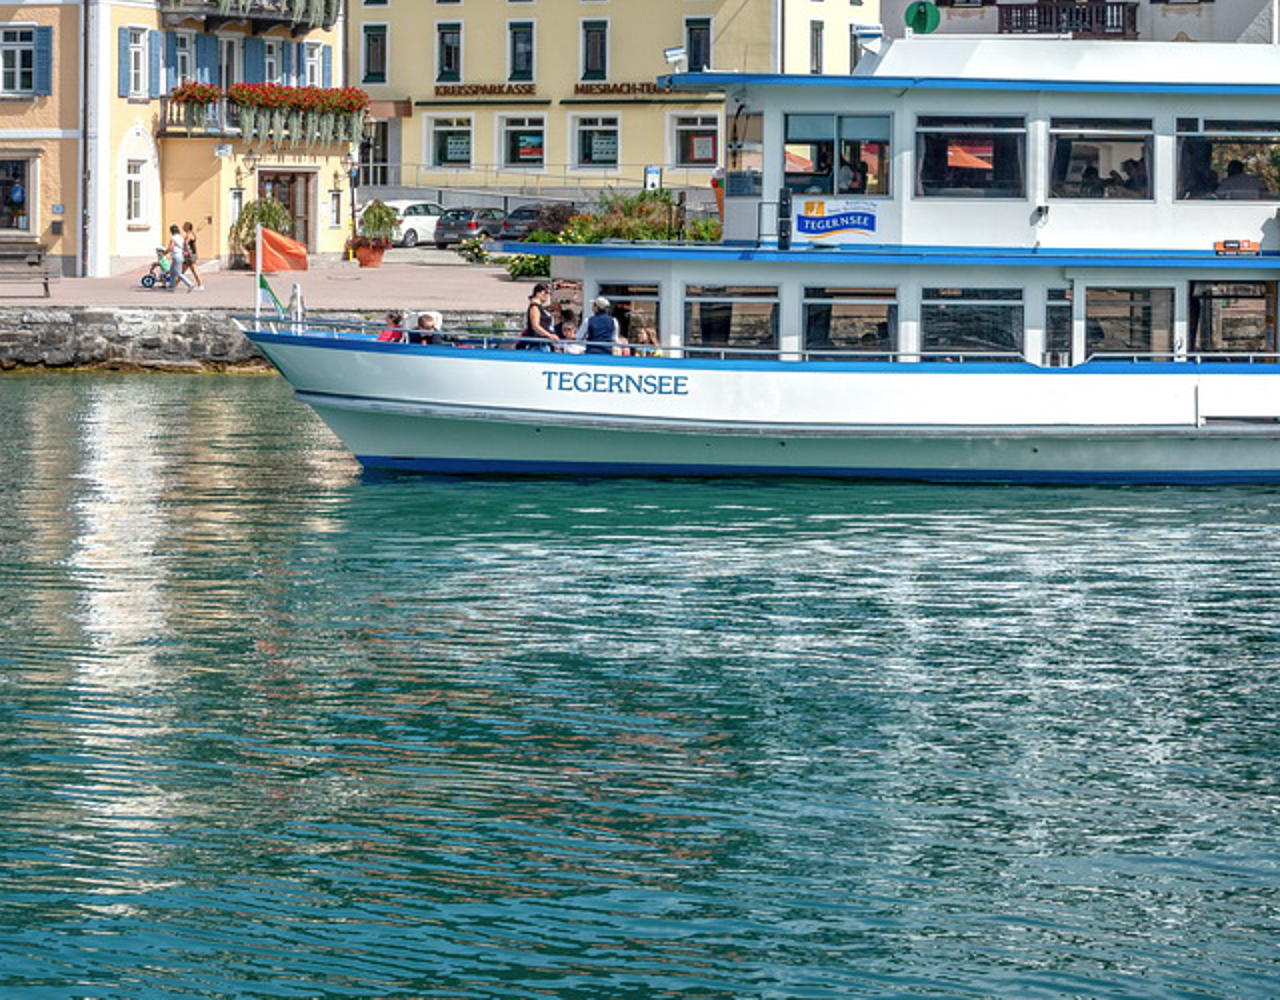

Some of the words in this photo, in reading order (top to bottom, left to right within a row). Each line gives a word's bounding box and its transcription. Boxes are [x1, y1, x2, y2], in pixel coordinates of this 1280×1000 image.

[434, 83, 537, 96] KREISSPARKASSE
[804, 214, 869, 231] TEGERNSEE
[542, 370, 689, 395] TEGERNSEE
